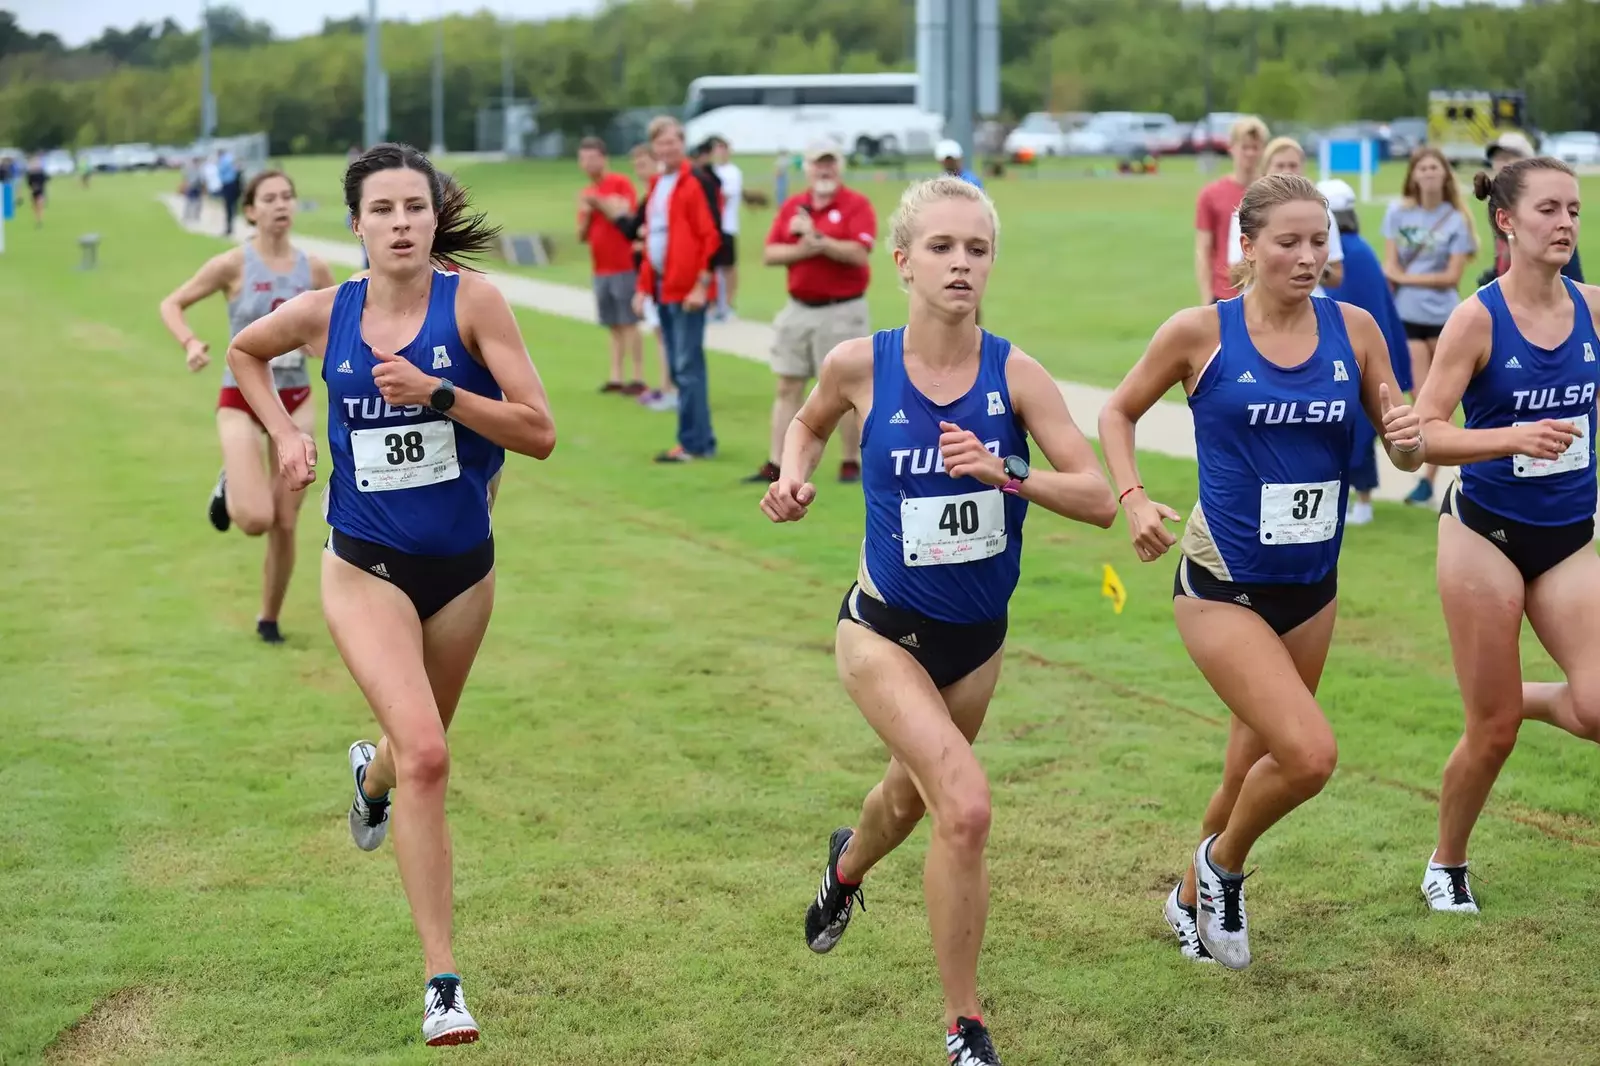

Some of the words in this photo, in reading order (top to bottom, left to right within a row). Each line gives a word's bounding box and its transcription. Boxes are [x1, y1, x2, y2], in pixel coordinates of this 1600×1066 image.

[343, 396, 424, 419] TULS
[1513, 382, 1595, 410] TULSA
[1247, 400, 1346, 425] TULSA
[384, 431, 425, 465] 38
[938, 500, 979, 536] 40
[1292, 488, 1323, 520] 37
